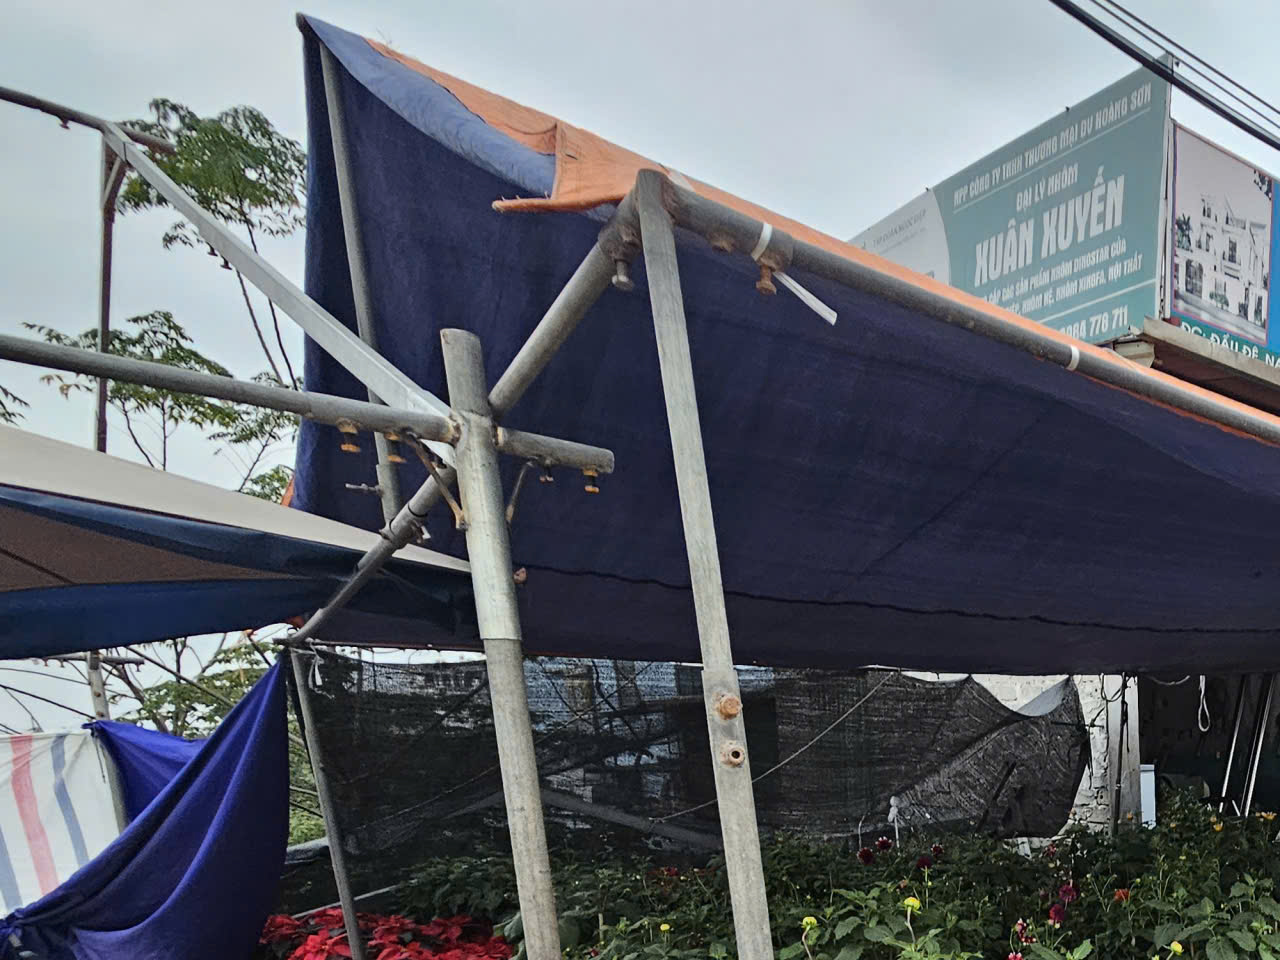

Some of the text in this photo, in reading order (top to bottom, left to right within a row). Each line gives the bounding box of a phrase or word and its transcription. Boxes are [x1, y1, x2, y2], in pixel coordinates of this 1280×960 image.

[969, 173, 990, 199] CÔNG
[992, 167, 1001, 186] TY
[1002, 158, 1023, 181] TNHH
[1024, 135, 1058, 169] THƯƠNG
[1060, 123, 1078, 150] MẠI
[1095, 95, 1128, 129] HOÀNG
[1130, 82, 1151, 110] SƠN
[1016, 162, 1079, 212] ĐẠI LÝ NHÔM
[974, 217, 1035, 288] XUÂN
[1041, 165, 1126, 260] XUYẾN
